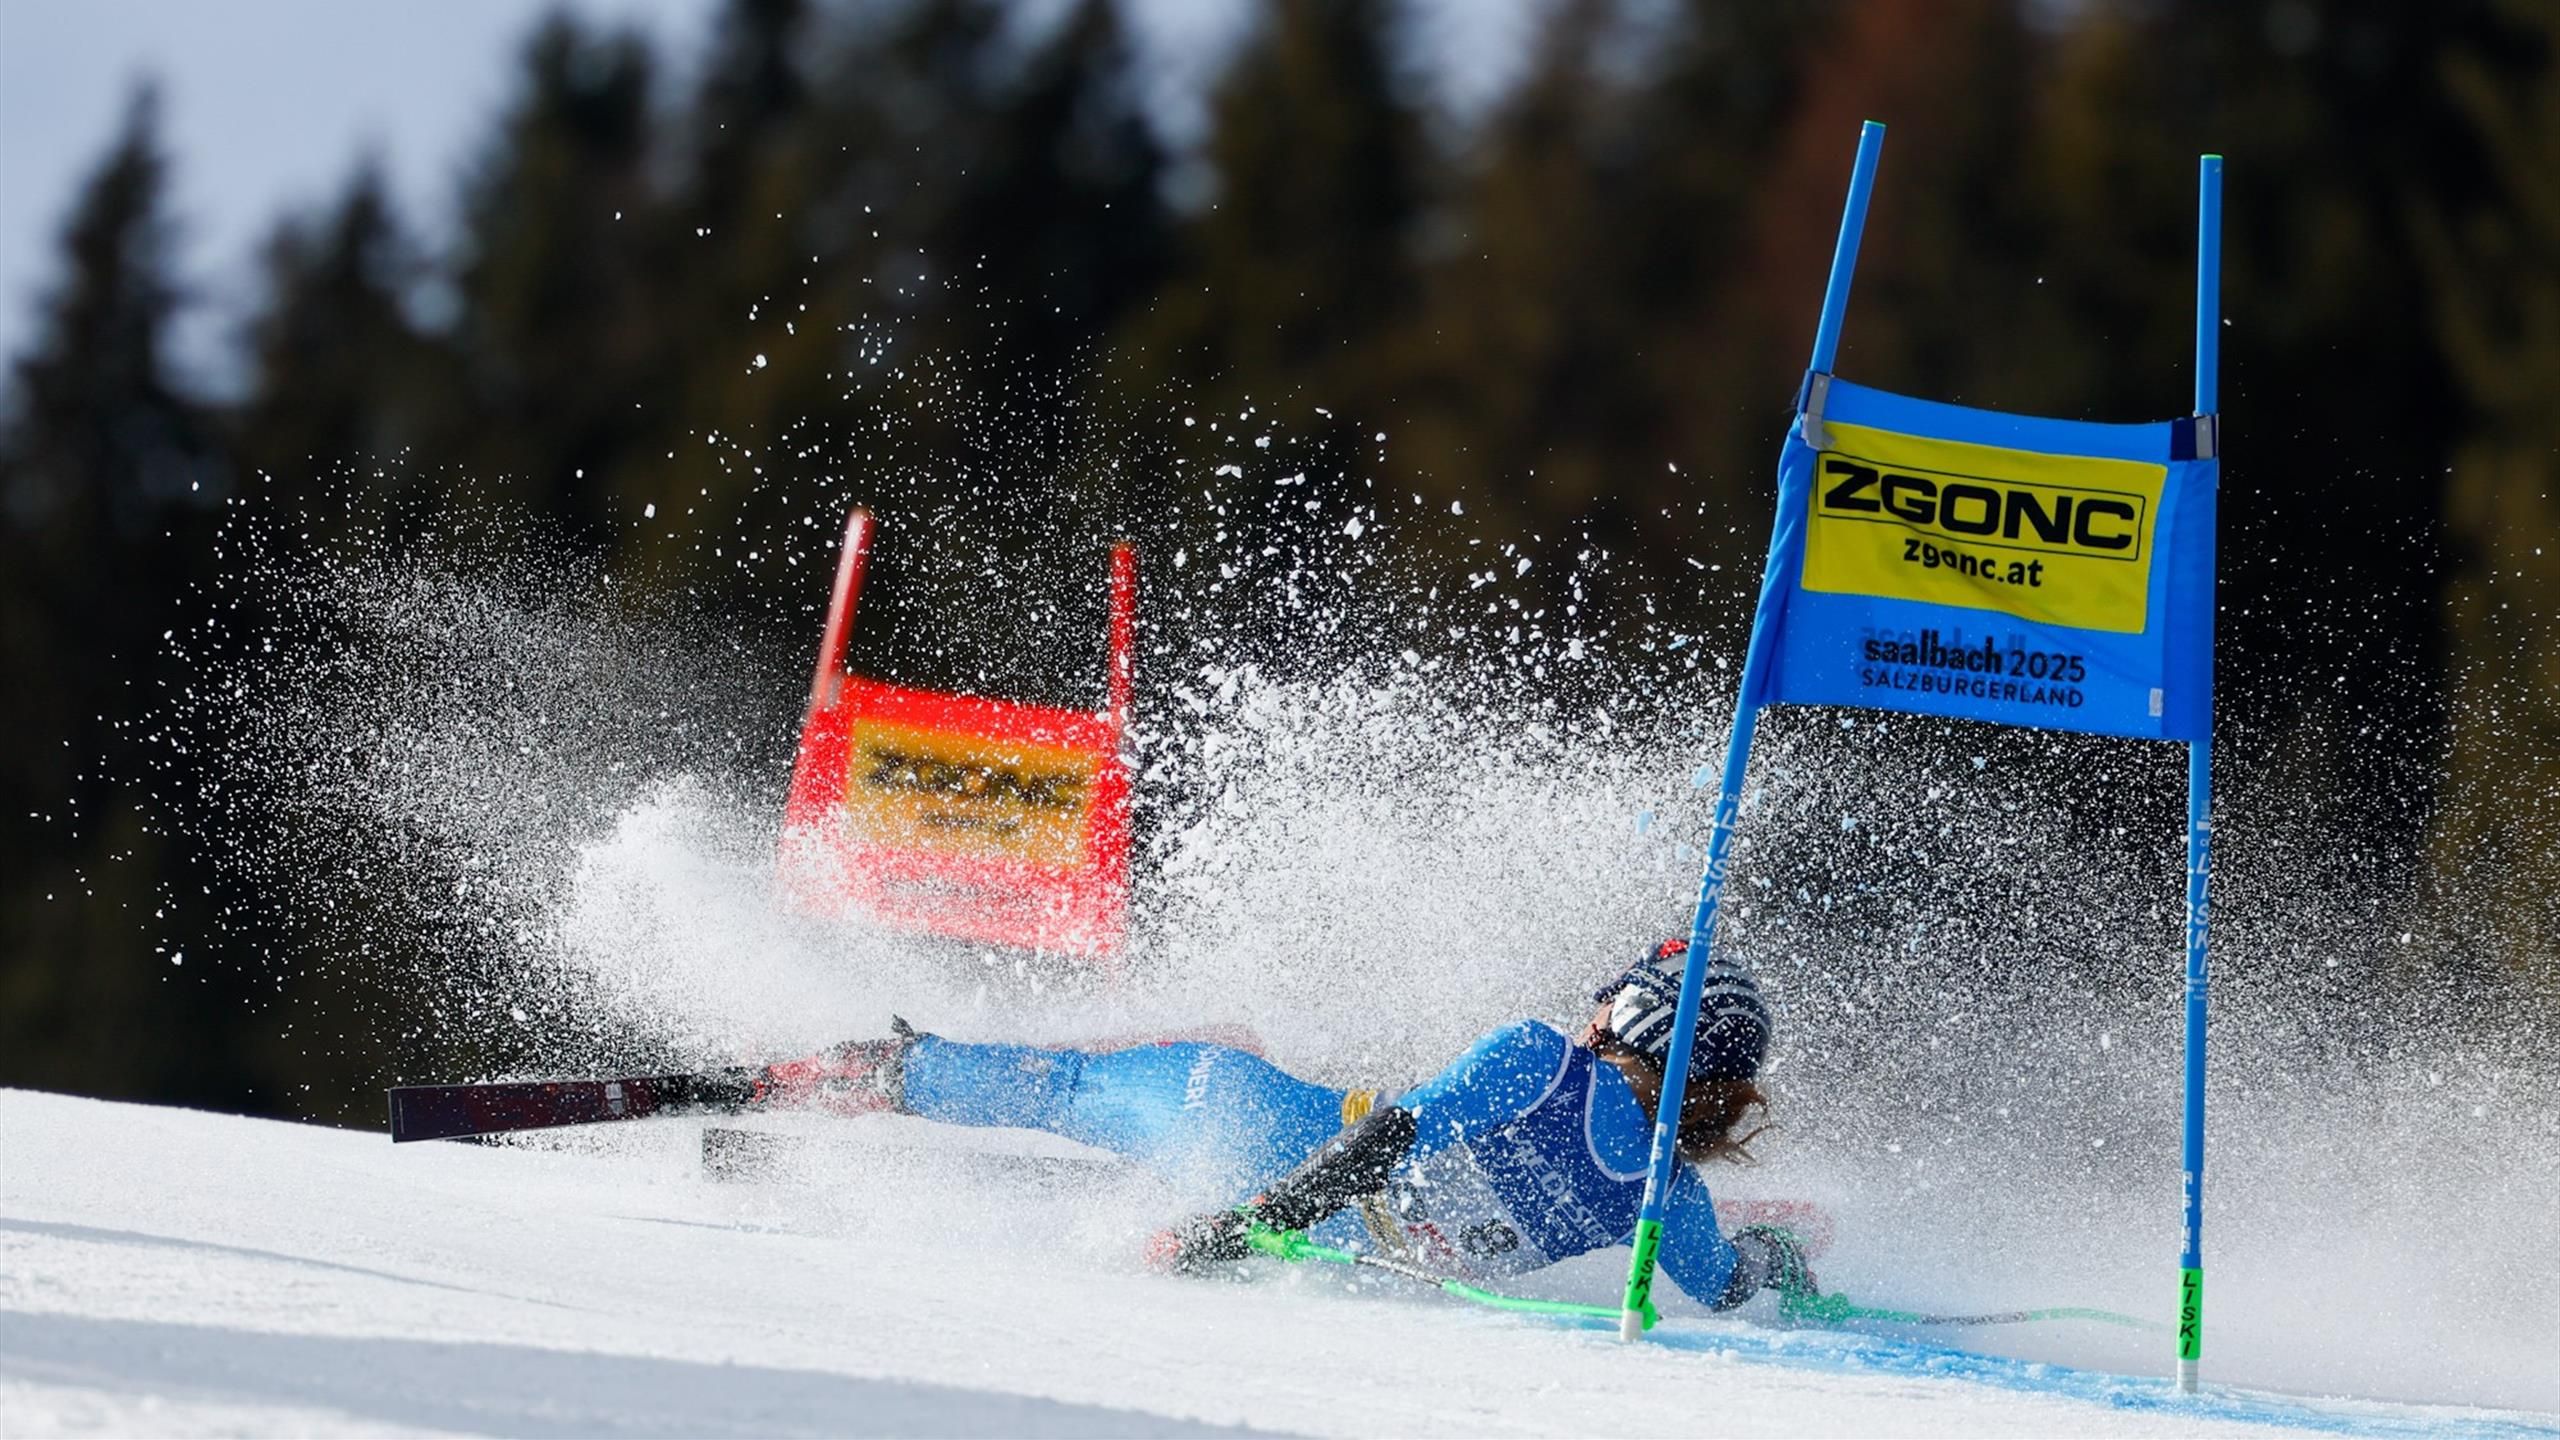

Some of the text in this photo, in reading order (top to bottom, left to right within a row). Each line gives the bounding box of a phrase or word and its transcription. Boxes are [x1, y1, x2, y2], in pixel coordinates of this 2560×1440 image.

[1824, 459, 2135, 551] ZGONC
[1903, 537, 2044, 588] zgonc.at
[1861, 668, 2085, 708] SALZBURGERLAND
[1864, 628, 2087, 683] saalbach 2025
[1704, 807, 1734, 930] LISKI
[1635, 1224, 1660, 1309] LISKI
[2179, 1272, 2198, 1357] LISKI
